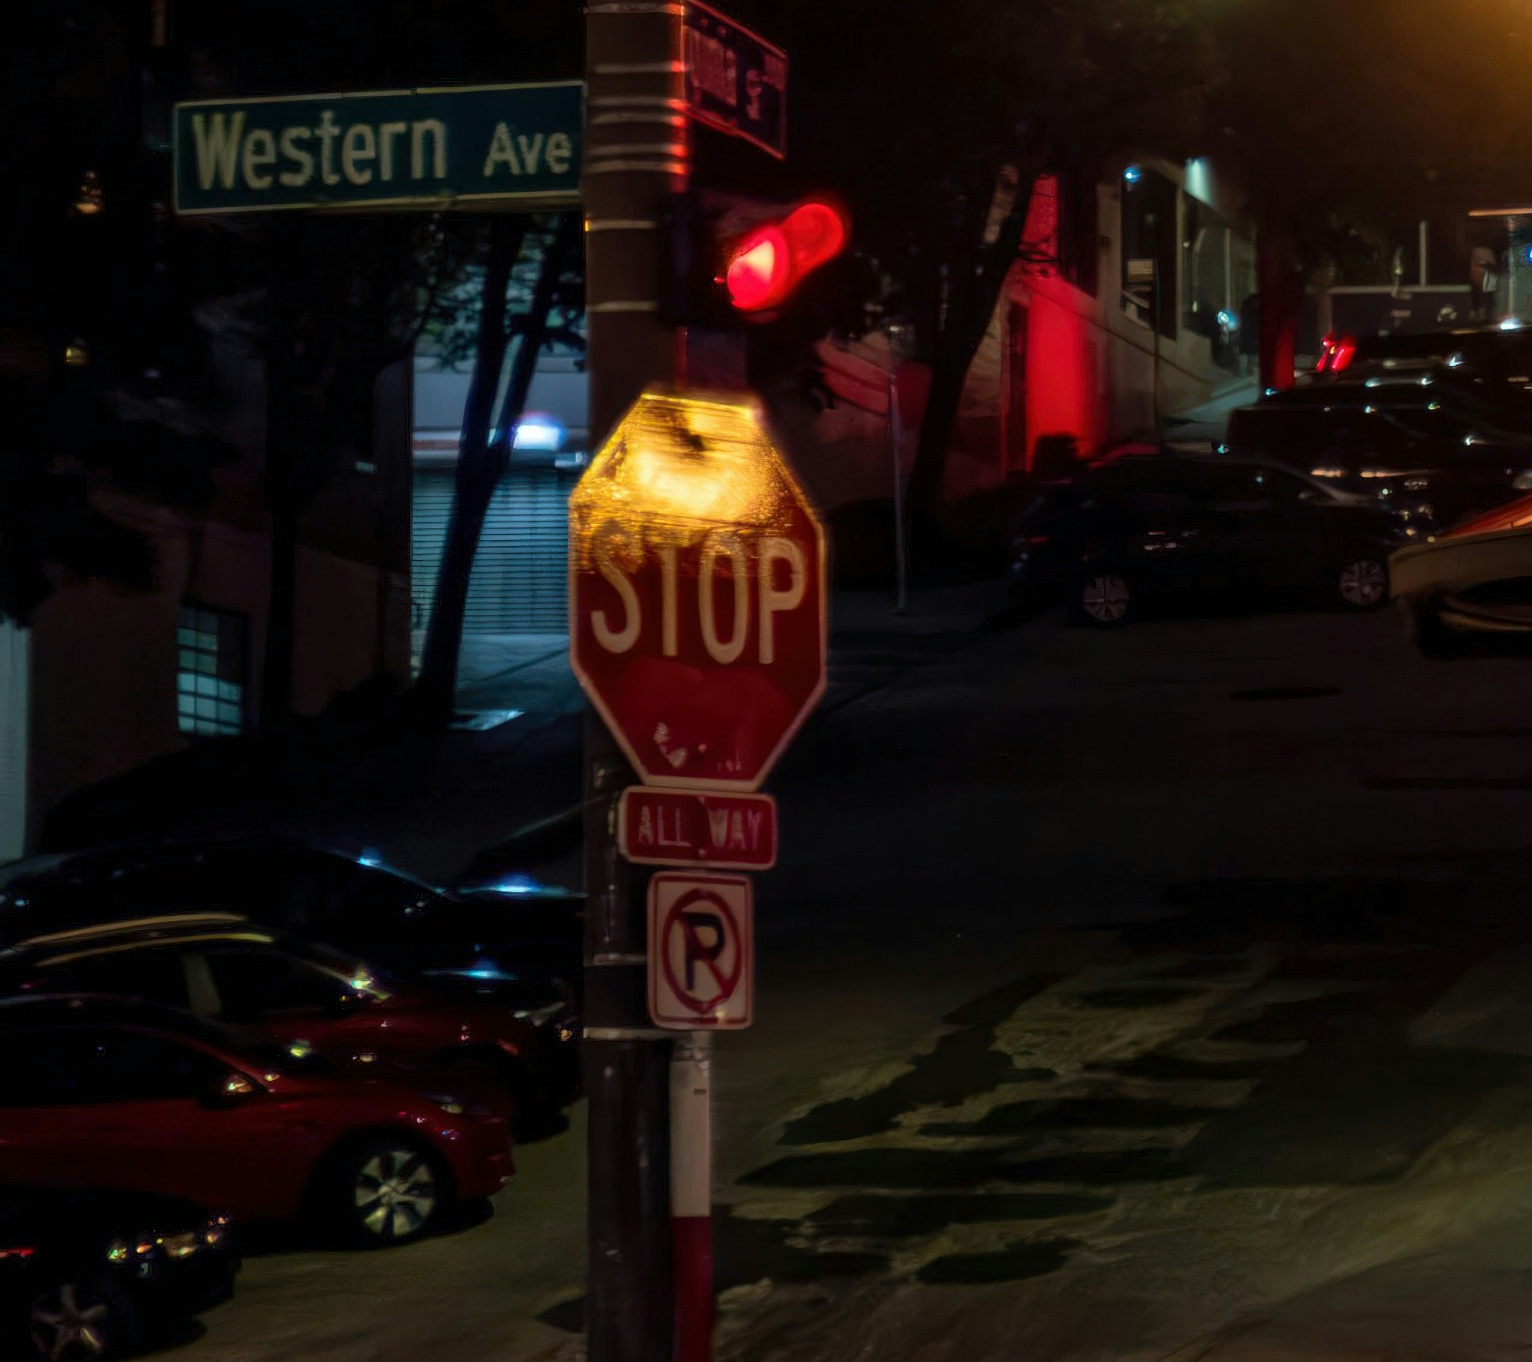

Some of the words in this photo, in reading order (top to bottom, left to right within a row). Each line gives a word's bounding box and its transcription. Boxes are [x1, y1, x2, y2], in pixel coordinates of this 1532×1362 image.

[191, 109, 447, 191] Western
[483, 121, 573, 178] Ave
[589, 520, 809, 666] STOP
[637, 804, 694, 847] ALL
[708, 806, 764, 851] WAY
